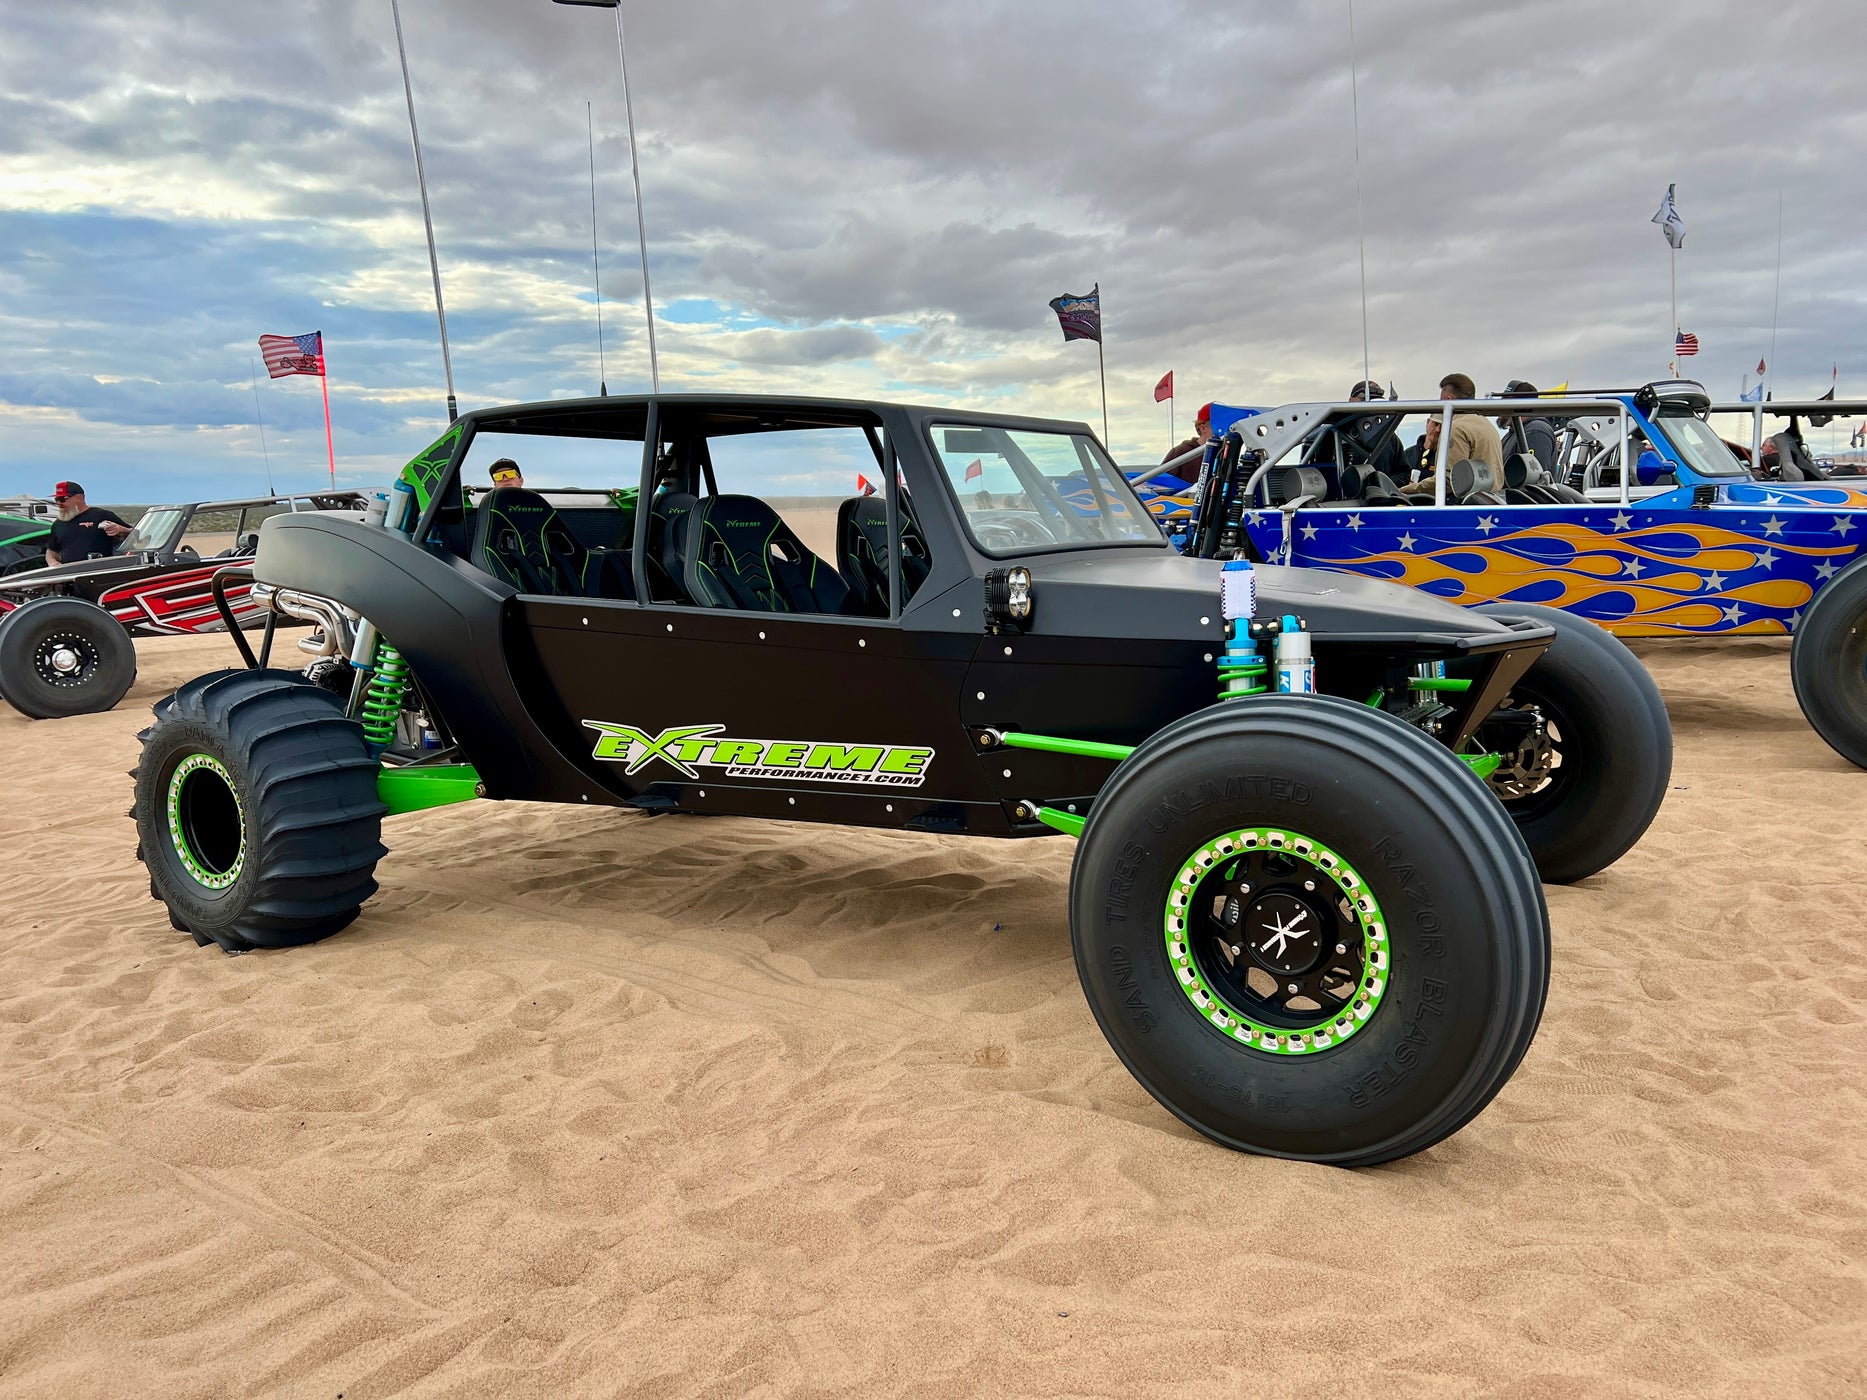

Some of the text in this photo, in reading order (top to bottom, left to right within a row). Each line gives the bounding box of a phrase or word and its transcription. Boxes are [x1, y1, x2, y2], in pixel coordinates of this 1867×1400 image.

[582, 719, 933, 778] EXTREME
[728, 767, 922, 785] PERFORMANCE1.COM
[1145, 774, 1314, 834] UNLIMITED
[1106, 841, 1145, 927] TIRES
[1106, 945, 1157, 1034] SAND
[1346, 835, 1449, 1110] RAZOR BLASTER
